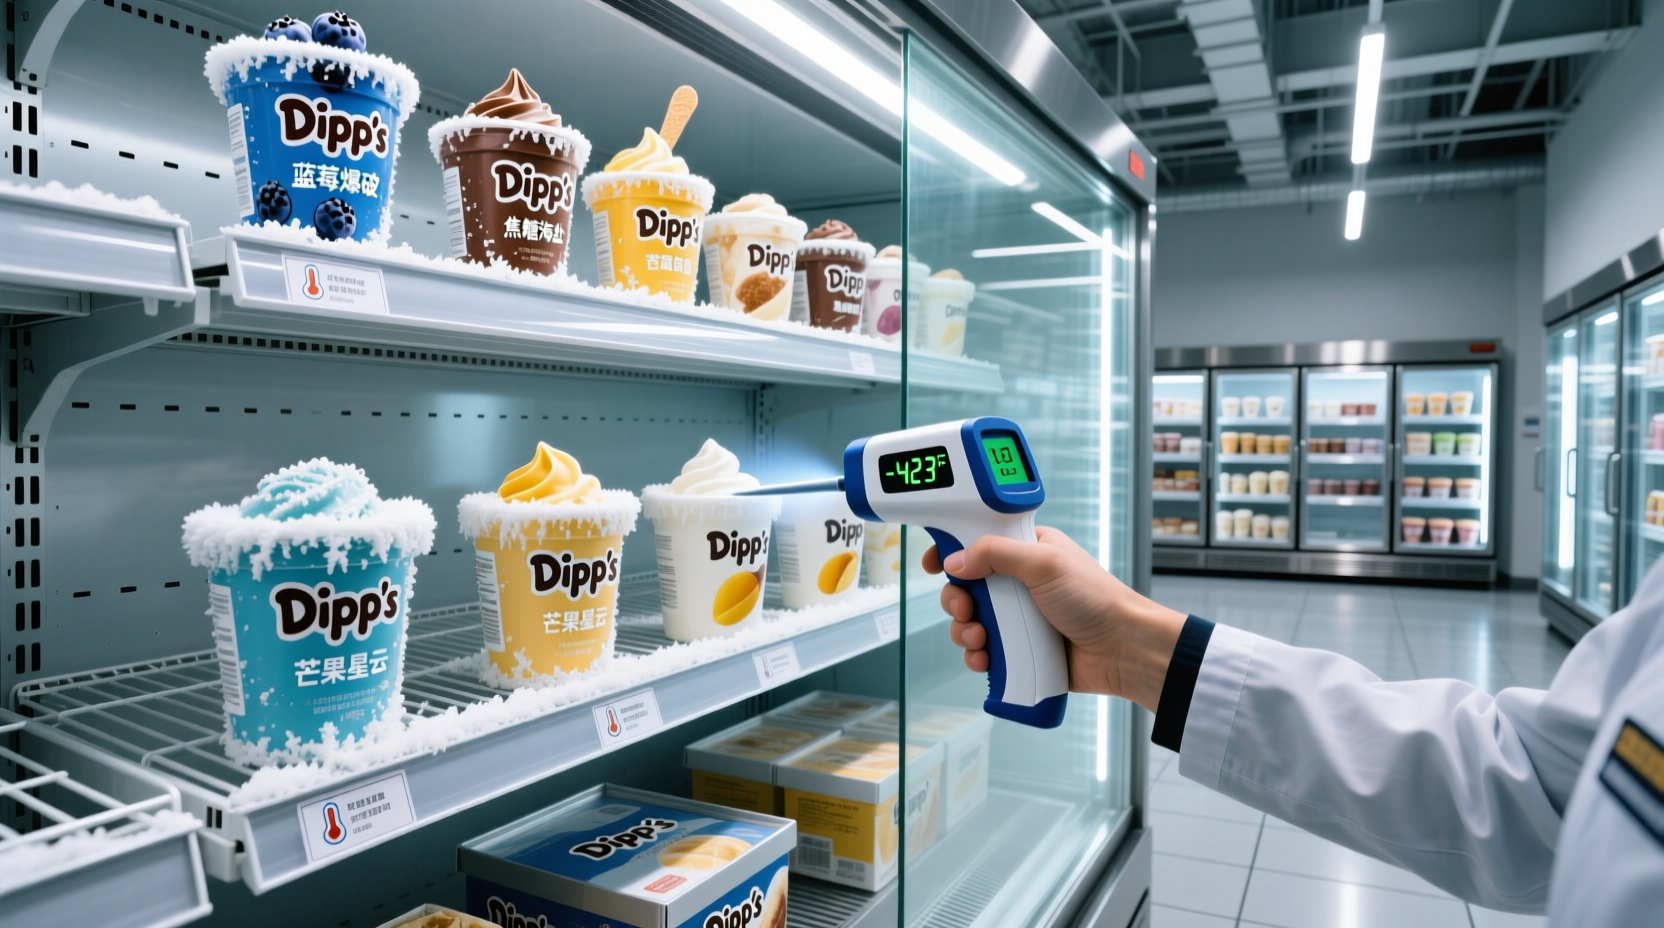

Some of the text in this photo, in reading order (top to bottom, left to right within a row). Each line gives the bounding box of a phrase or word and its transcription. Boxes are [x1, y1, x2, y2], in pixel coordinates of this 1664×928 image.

[279, 98, 387, 156] Dipp's
[291, 162, 381, 198] 蓝莓爆破
[494, 163, 572, 211] Dipp's
[636, 208, 699, 247] Dipp's
[706, 530, 768, 566] Dipp's
[529, 549, 618, 598] Dipp's
[275, 581, 398, 641] Dipp's
[542, 606, 607, 634] 芒果星云
[294, 648, 389, 687] 芒果星云
[572, 818, 676, 859] Dipp's
